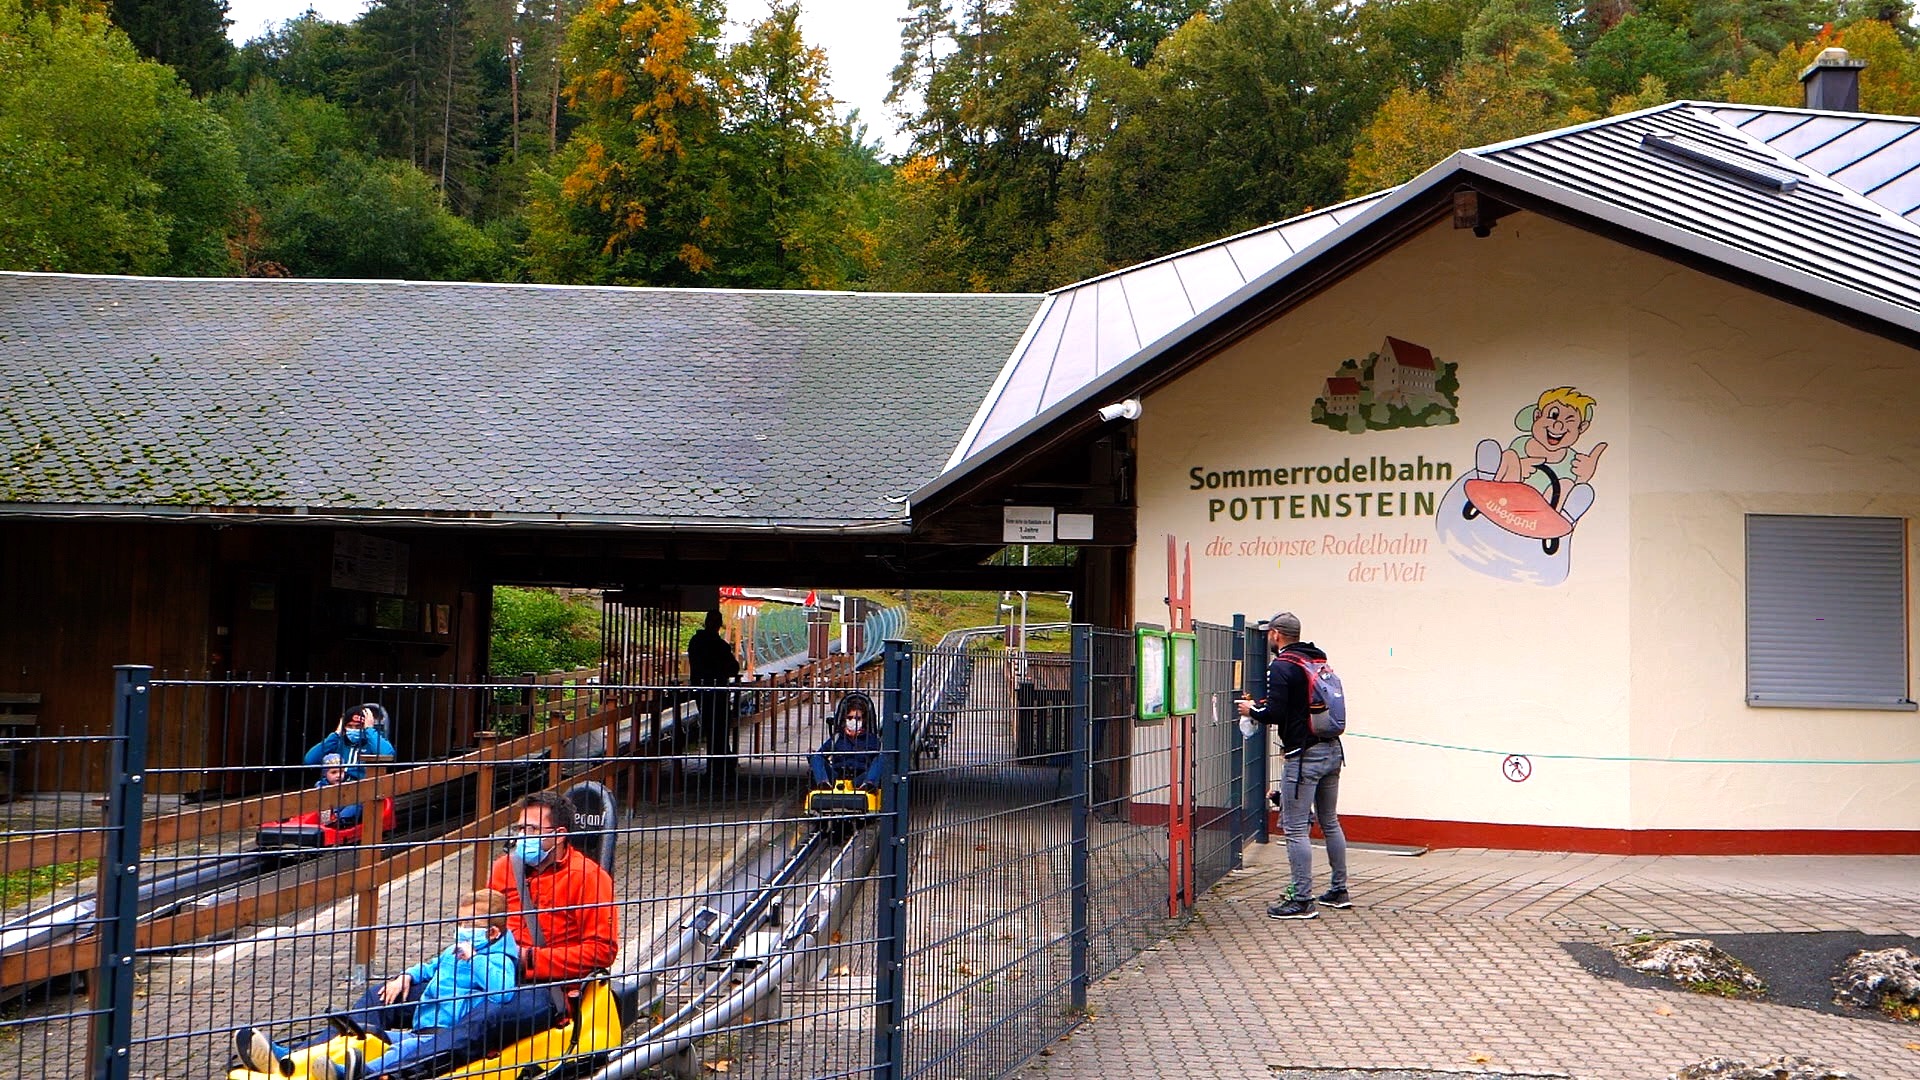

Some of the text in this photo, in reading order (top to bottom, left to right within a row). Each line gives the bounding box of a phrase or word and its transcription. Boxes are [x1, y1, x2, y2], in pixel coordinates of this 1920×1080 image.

[1189, 455, 1453, 491] Sommerrodelbahn
[1208, 491, 1435, 522] POTTENSTEIN
[1486, 497, 1538, 531] wiegand
[1205, 532, 1429, 557] die schönste Rodelbahn
[1348, 561, 1427, 583] der Welt
